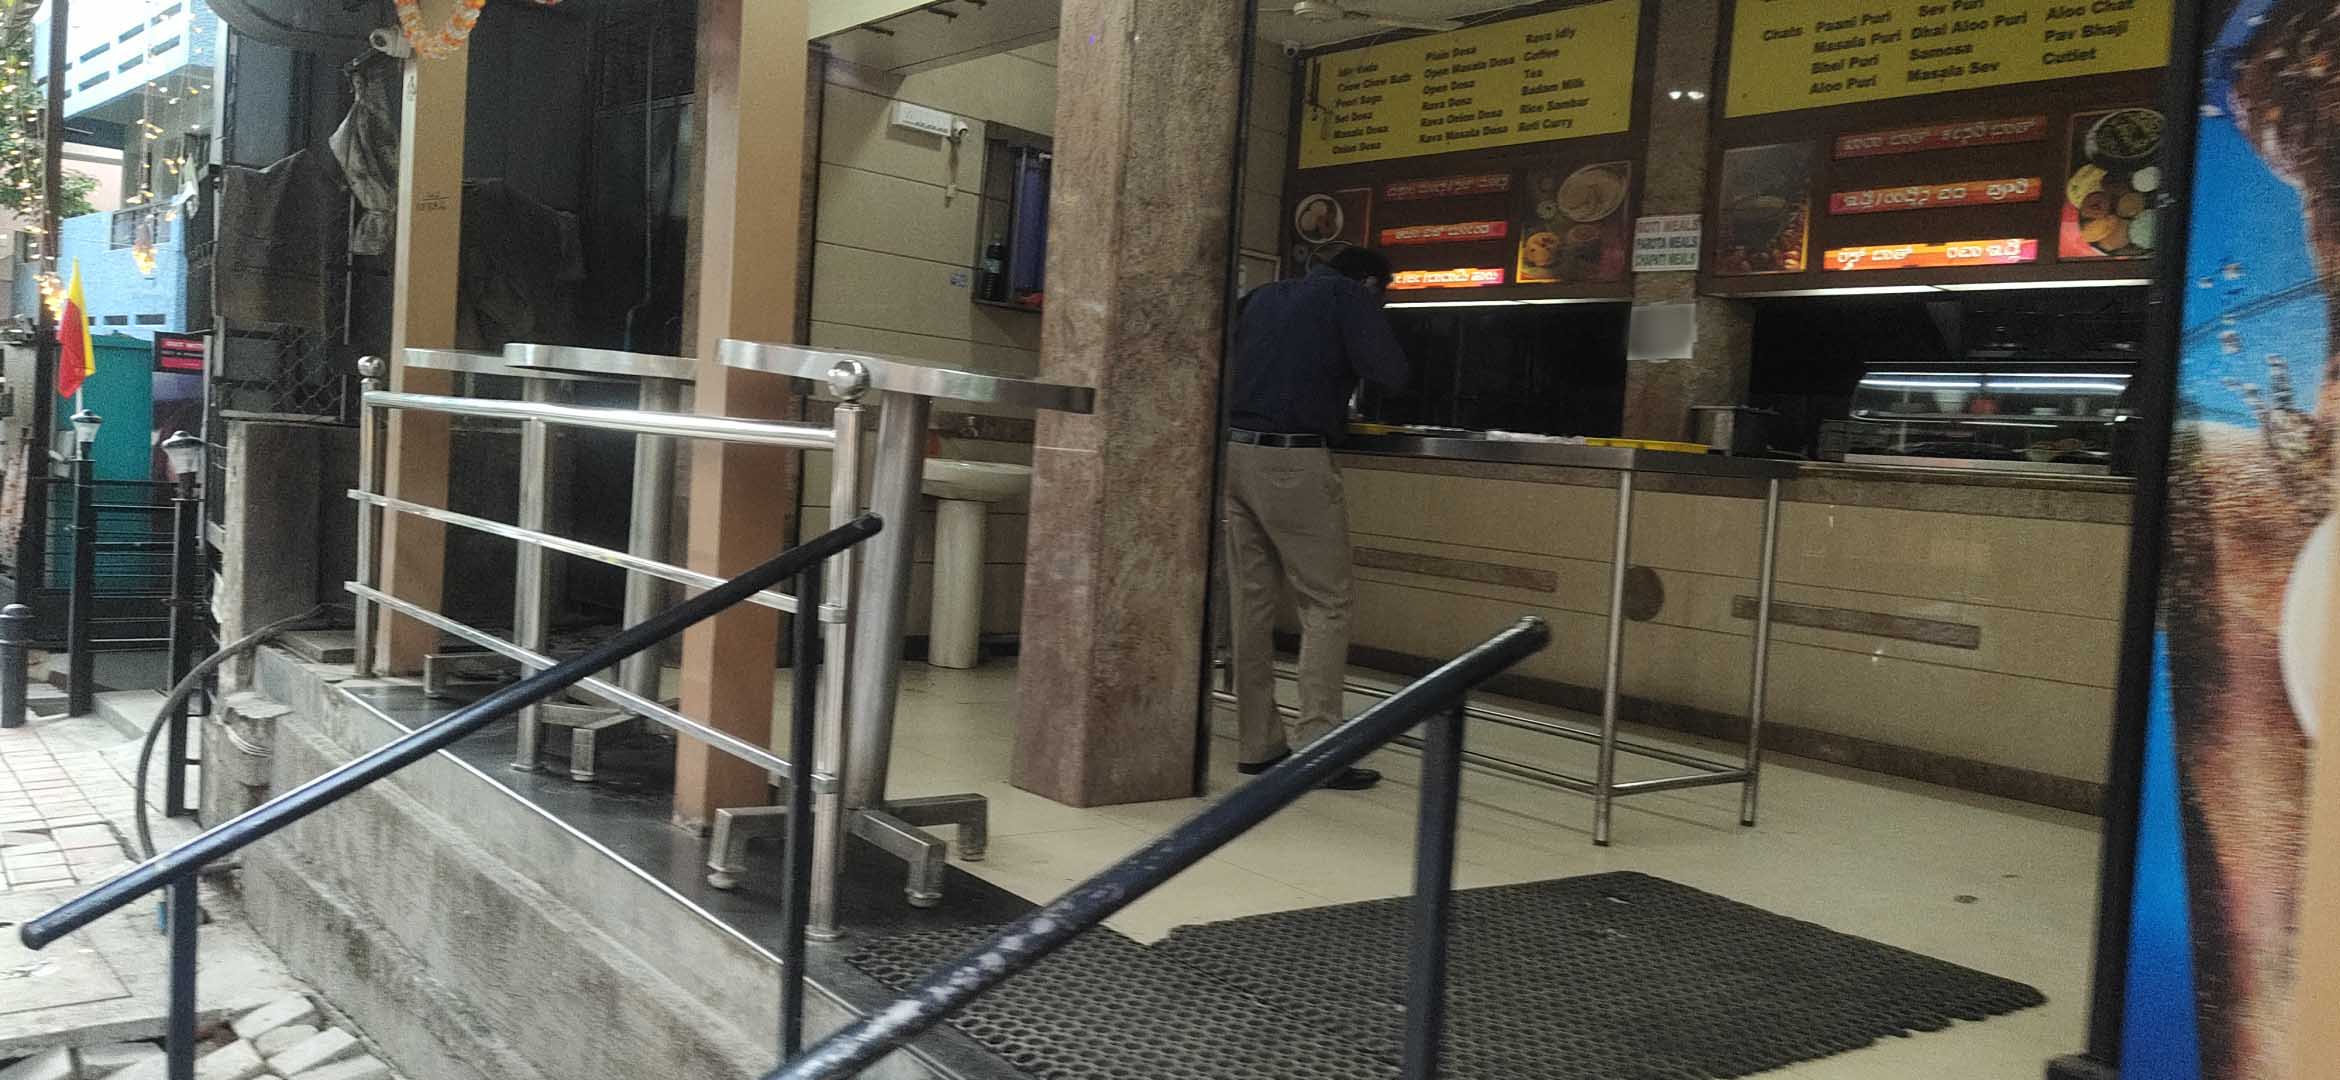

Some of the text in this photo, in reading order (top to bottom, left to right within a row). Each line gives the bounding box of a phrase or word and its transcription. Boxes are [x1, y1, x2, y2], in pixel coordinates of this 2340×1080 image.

[1860, 11, 1892, 25] Puri
[1918, 5, 1947, 17] Sev
[2045, 6, 2085, 20] Aloo
[1952, 20, 1988, 33] Aloo
[1994, 11, 2028, 26] Puri
[1526, 33, 1552, 43] Rava
[2044, 20, 2129, 42] Pav Bhaji
[1814, 28, 1902, 52] Masala Puri
[1453, 47, 1477, 57] Dosa
[1523, 49, 1560, 61] Coffee
[1910, 44, 1973, 60] Samosa
[2042, 48, 2096, 64] Cutlet
[1424, 57, 1514, 80] Open Masala Dosa
[1848, 55, 1878, 68] Puri
[1523, 69, 1543, 78] Tea
[1907, 62, 2000, 81] Masala Sev
[1423, 80, 1475, 96] Open Dosa
[1520, 78, 1584, 96] Badam Milk
[1809, 75, 1877, 94] Aloo Puri
[1422, 98, 1472, 110] Rava Dosa
[1519, 98, 1590, 113] Rice Sambar
[1351, 112, 1373, 121] Dosa
[1421, 110, 1503, 127] Rava Onion Dosa
[1334, 126, 1389, 139] Masala Dosa
[1517, 119, 1573, 132] Roti Curry
[1419, 126, 1508, 143] Rava Masala Dosa
[1360, 142, 1381, 151] Dosa
[1664, 219, 1698, 232] MEALS
[1669, 236, 1698, 248] MEALS
[1669, 253, 1696, 265] MEALS
